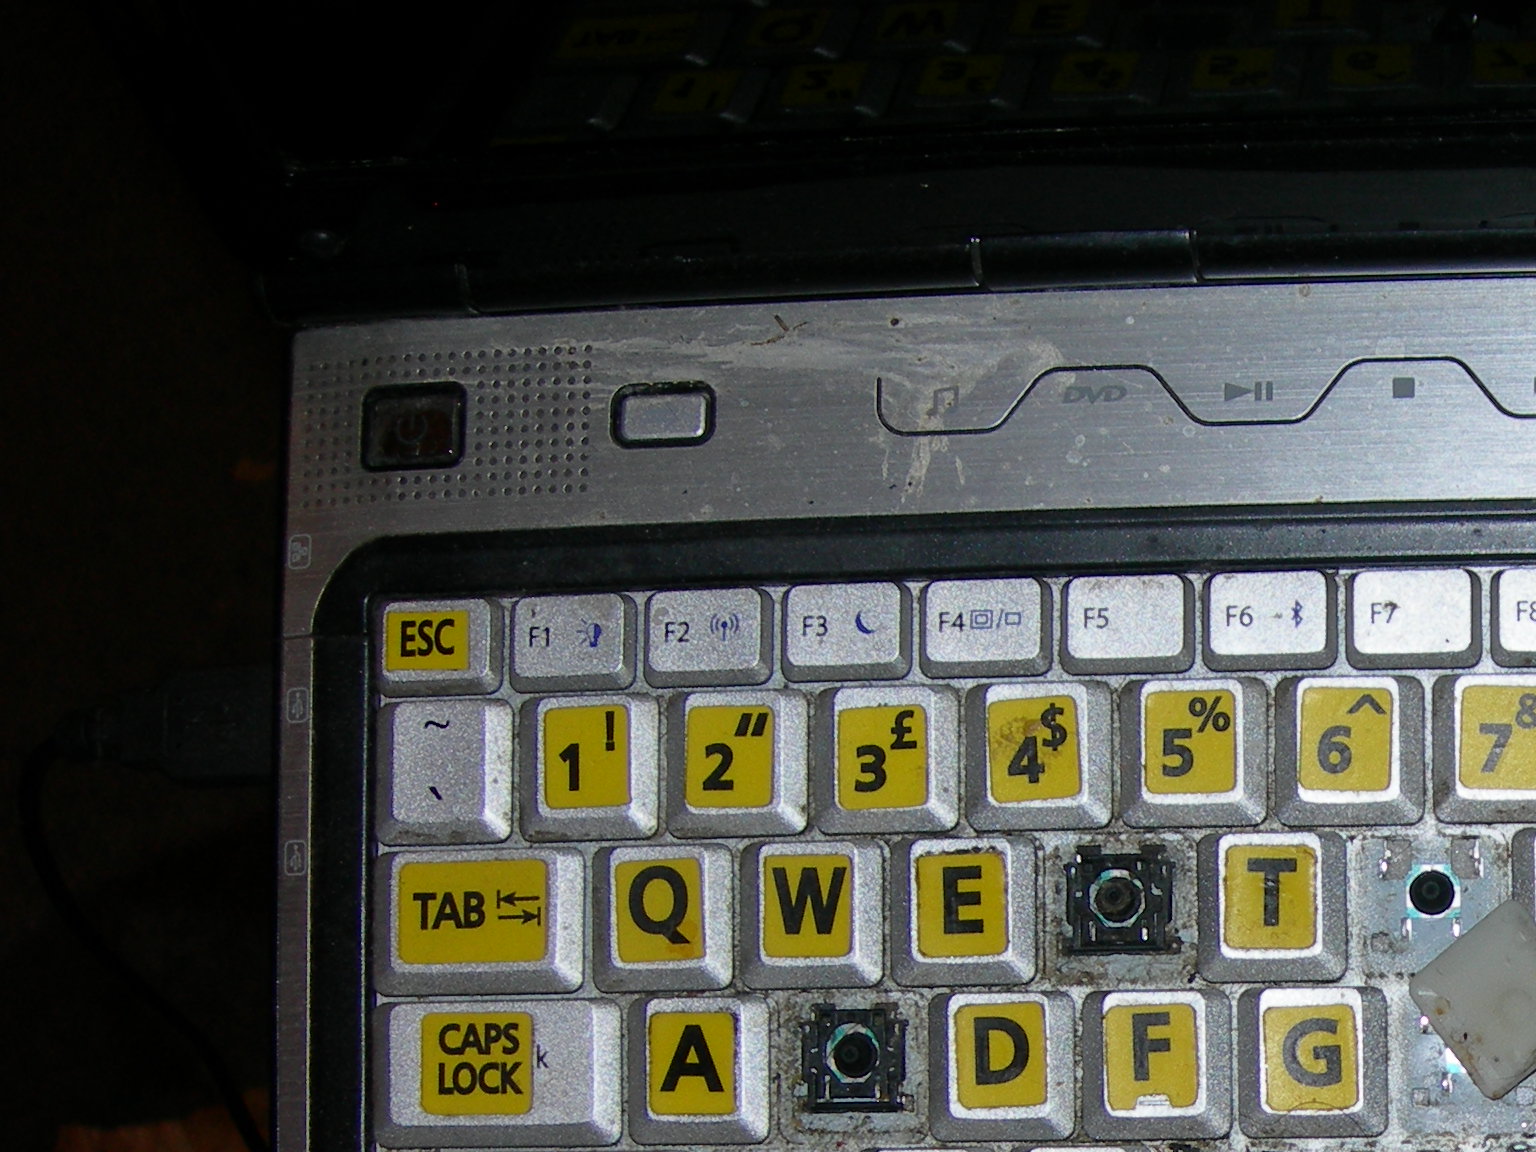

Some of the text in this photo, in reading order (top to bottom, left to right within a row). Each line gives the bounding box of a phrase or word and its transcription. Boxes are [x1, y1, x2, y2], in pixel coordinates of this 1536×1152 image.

[662, 620, 690, 644] F2
[801, 616, 829, 639] F3
[937, 611, 965, 634] F4
[1083, 609, 1110, 630] F5
[1225, 605, 1254, 628] F6
[1370, 603, 1398, 624] F7
[399, 618, 457, 658] ESC
[527, 625, 552, 649] F1
[413, 891, 487, 931] TAB
[628, 869, 691, 945] Q
[771, 865, 848, 937] W
[942, 865, 985, 936] E
[1246, 857, 1298, 928] T
[437, 1023, 521, 1057] CAPS
[658, 1024, 725, 1093] A
[973, 1017, 1031, 1086] D
[1131, 1012, 1172, 1082] F
[1281, 1017, 1344, 1089] G
[436, 1060, 525, 1096] LOCK
